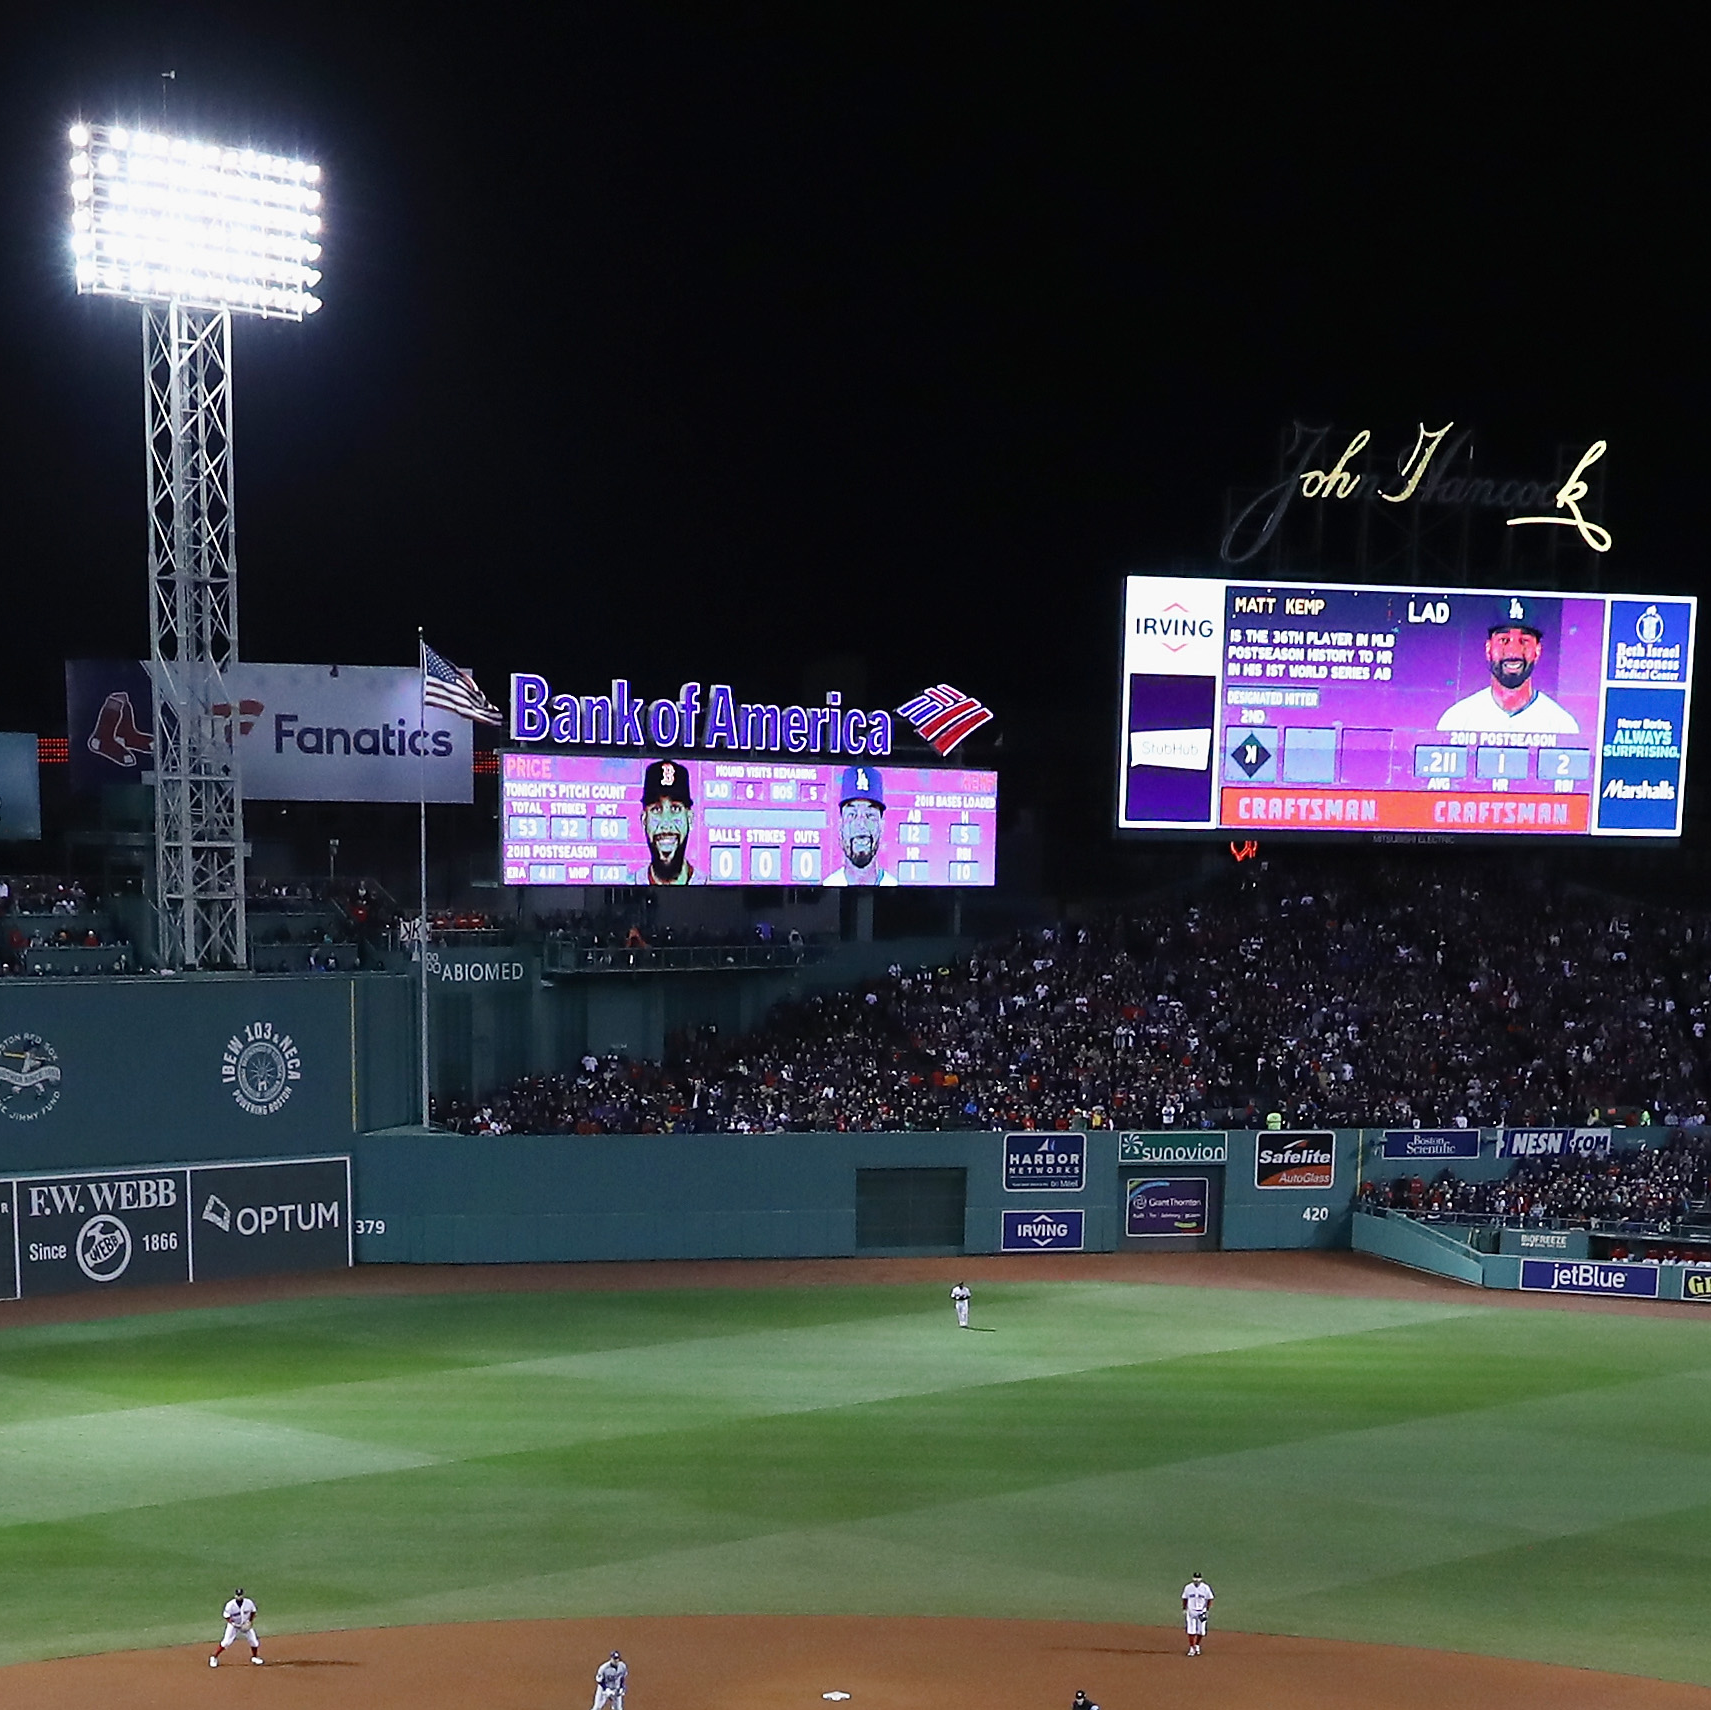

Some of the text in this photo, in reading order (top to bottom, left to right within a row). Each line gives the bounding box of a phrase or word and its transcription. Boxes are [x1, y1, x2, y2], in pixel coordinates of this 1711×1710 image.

[1235, 597, 1325, 615] MATT KEMP
[1408, 602, 1450, 623] LAD
[1136, 618, 1213, 637] IRVING
[1246, 630, 1303, 644] THE 36TH
[1228, 647, 1304, 661] POSTSEASON
[1289, 665, 1328, 679] WORLD
[510, 673, 891, 755] Bank of America
[274, 714, 454, 758] Fanatics
[1480, 732, 1556, 747] POSTSEASON
[1613, 730, 1672, 746] ALWAYS
[1142, 741, 1198, 755] StubHub
[1603, 744, 1680, 759] SURPRISING.
[506, 758, 551, 778] PRICE
[505, 783, 626, 800] TONIGHT'S PITCH COUNT
[1603, 779, 1674, 799] Marshalls
[512, 802, 542, 814] TOTAL
[1240, 797, 1376, 821] CRAFTSMAN
[1434, 801, 1568, 824] CRAFTSMAN
[518, 819, 537, 835] 53
[560, 821, 578, 837] 32
[600, 822, 618, 838] 60
[794, 830, 819, 844] OUTS
[533, 846, 597, 858] POSTSEASON
[442, 963, 524, 981] ABIOMED
[244, 1022, 272, 1041] 103
[279, 1035, 301, 1079] NECA
[1414, 1135, 1444, 1145] Boston
[1511, 1133, 1563, 1154] NESN
[1142, 1143, 1224, 1160] sunovion
[1407, 1143, 1455, 1154] Scientific
[1010, 1154, 1079, 1165] HARBOR
[1260, 1149, 1331, 1166] Safelite
[1279, 1172, 1330, 1184] AutoGlass
[88, 1179, 177, 1211] WEBB
[236, 1201, 339, 1235] OPTUM
[1302, 1206, 1329, 1221] 420
[356, 1220, 386, 1234] 379
[1017, 1224, 1068, 1237] IRVING
[142, 1232, 178, 1251] 1866
[29, 1243, 67, 1262] Since
[1551, 1265, 1626, 1289] jetBlue
